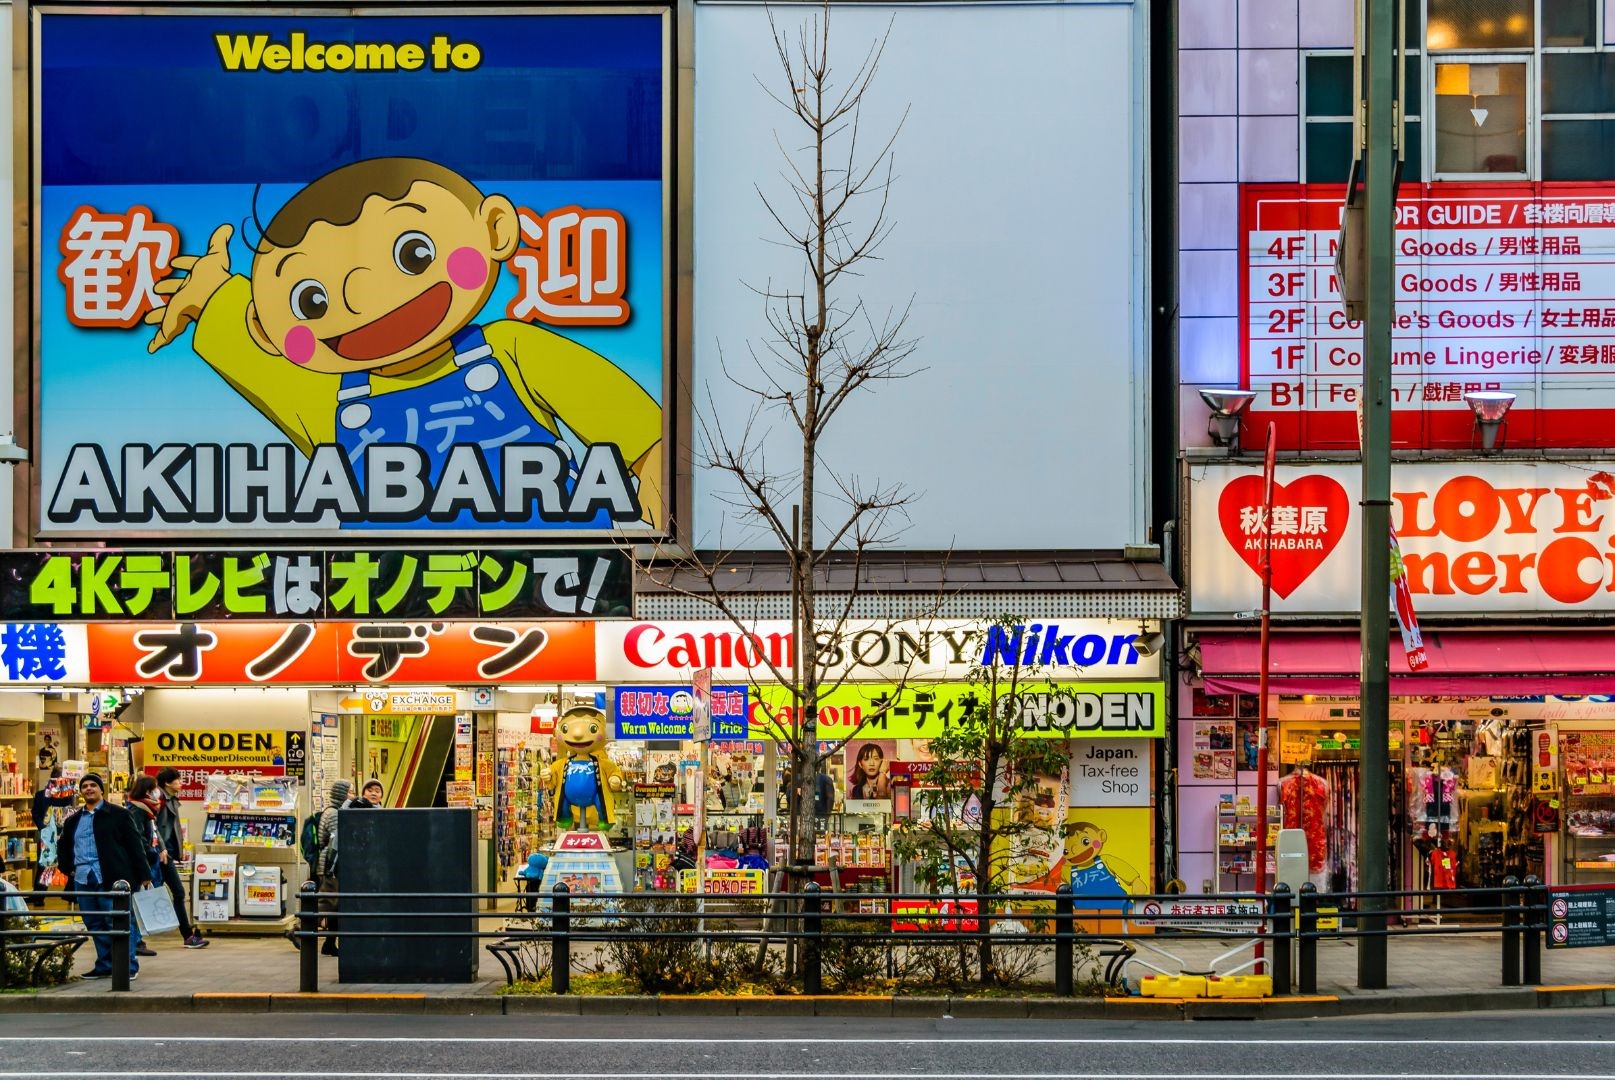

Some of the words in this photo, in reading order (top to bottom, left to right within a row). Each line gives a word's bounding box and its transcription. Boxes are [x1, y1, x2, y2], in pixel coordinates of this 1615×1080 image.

[216, 33, 426, 71] Welcome
[431, 35, 482, 71] to
[1427, 204, 1501, 226] GUIDE
[1267, 237, 1306, 260] 4F
[1400, 238, 1477, 257] Goods
[1498, 236, 1581, 255] 男性用品
[64, 211, 173, 322] 歓
[513, 211, 625, 321] 迎
[1267, 273, 1306, 297] 3F
[1400, 274, 1477, 293] Goods
[1498, 272, 1581, 292] 男性用品
[1267, 310, 1306, 333] 2F
[1438, 310, 1515, 329] Goods
[1540, 308, 1615, 328] 女士用品
[1271, 346, 1306, 370] 1F
[1328, 346, 1437, 367] Coume
[1445, 345, 1542, 369] Lingerie
[1270, 383, 1305, 407] B1
[50, 443, 641, 521] AKIHABARA
[1239, 505, 1329, 536] 秋葉原
[1391, 475, 1606, 542] LOVE
[1244, 538, 1324, 551] AKIHABARA
[28, 552, 612, 615] 4Kテレビはオノデンで!
[1, 623, 68, 682] 機
[134, 622, 550, 682] オノデン
[622, 624, 793, 669] Canon
[813, 630, 981, 667] SONY
[980, 624, 1140, 667] Nikon
[391, 696, 453, 705] EXCHANGE
[620, 691, 669, 717] 親切な
[711, 691, 744, 716] 器店
[747, 700, 862, 727] Caon
[995, 692, 1154, 732] ONODEN
[621, 722, 647, 735] Warm
[648, 722, 682, 735] Welcome
[719, 722, 743, 735] Price
[157, 733, 273, 752] ONODEN
[1086, 746, 1138, 762] Japan.
[1080, 764, 1139, 778] Tax-free
[1101, 780, 1139, 796] Shop
[566, 837, 598, 847] オノデン
[704, 879, 757, 894] 50%OFF
[1073, 869, 1111, 889] オノデン
[1170, 904, 1260, 915] 歩行者天国実施中
